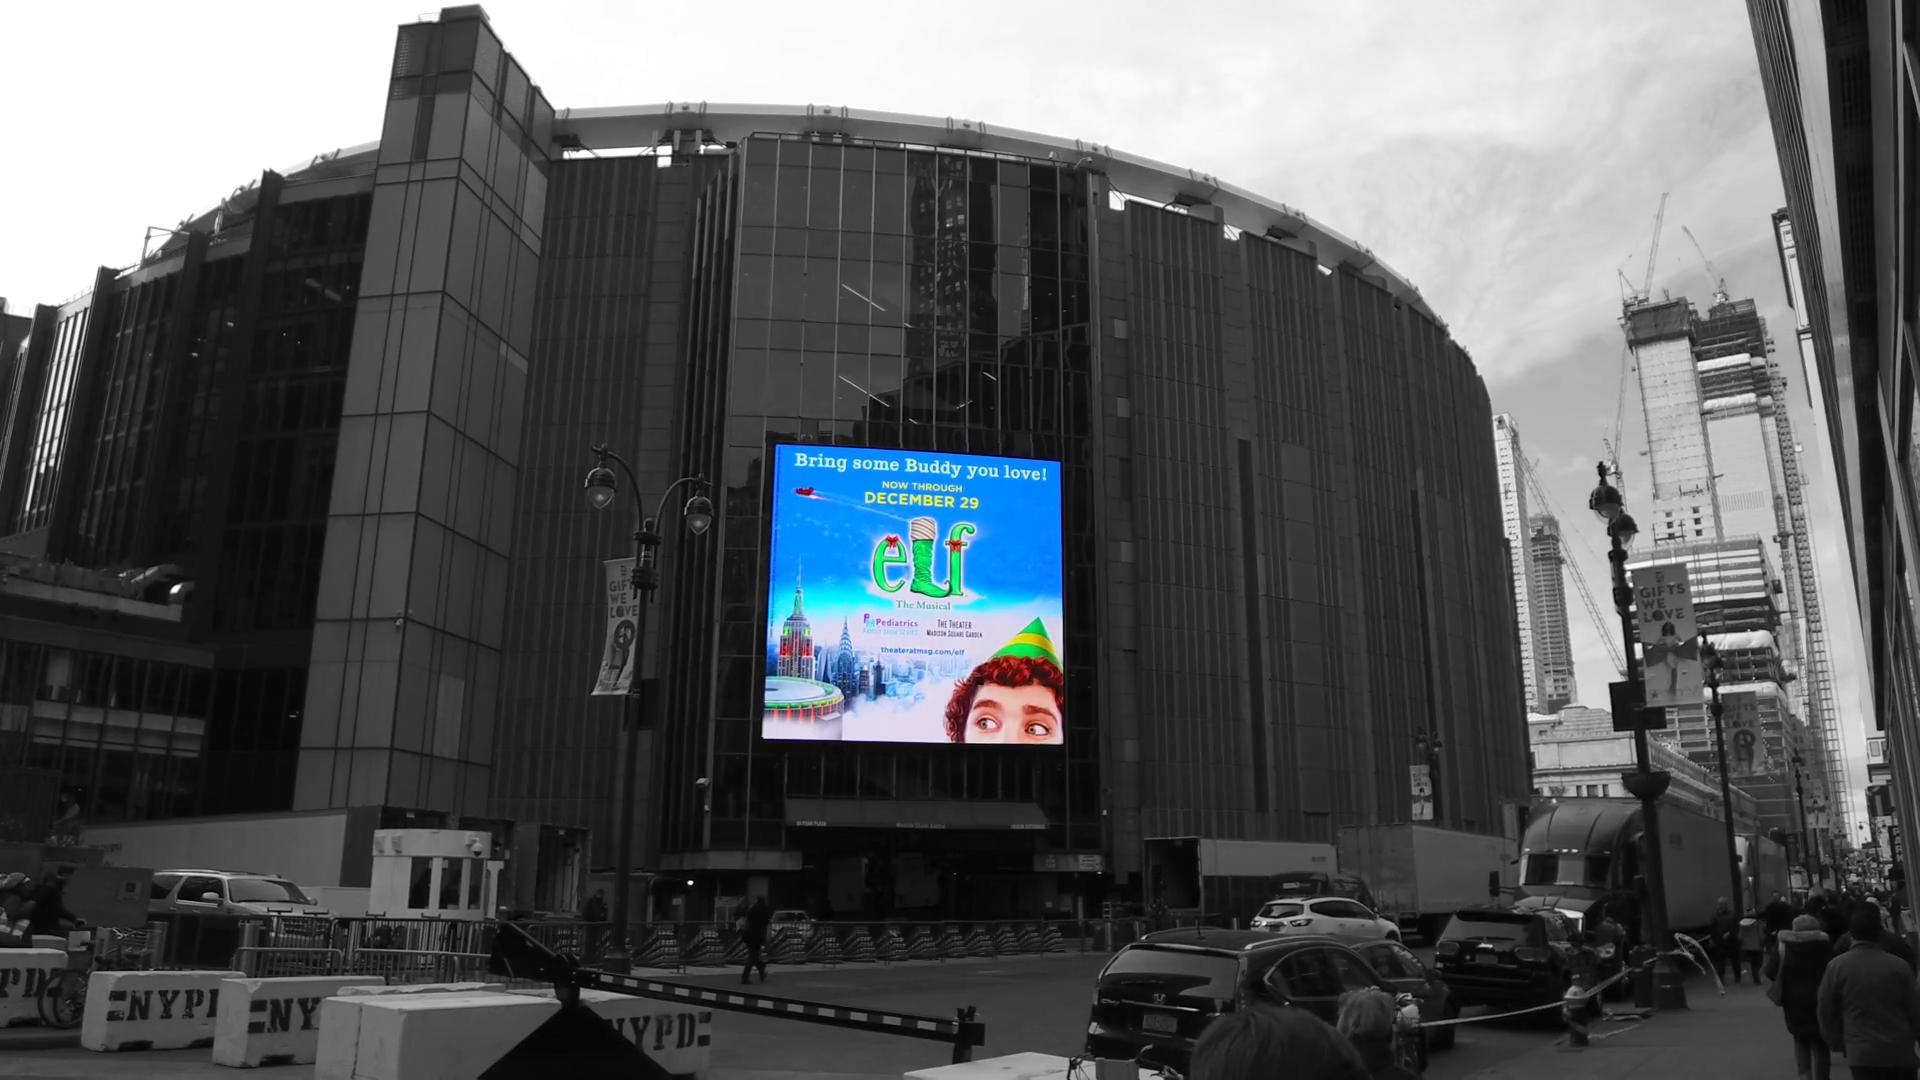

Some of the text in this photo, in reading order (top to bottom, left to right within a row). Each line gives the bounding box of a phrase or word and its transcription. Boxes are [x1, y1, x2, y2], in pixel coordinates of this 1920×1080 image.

[794, 453, 1047, 481] Bring some Buddy you love!
[882, 481, 963, 493] NOW THROUGH
[864, 491, 979, 509] DECEMBER 29
[609, 578, 633, 592] GIFT
[1640, 583, 1686, 598] GIFTS
[610, 593, 627, 604] WE
[896, 600, 951, 610] The Musical
[1641, 598, 1667, 610] WE
[610, 604, 638, 619] LOVE
[1643, 608, 1685, 623] LOVE
[876, 618, 918, 628] Pediatrics
[881, 647, 965, 656] theateratmsg.com/elf
[1892, 827, 1904, 862] PARK
[267, 997, 321, 1033] NY
